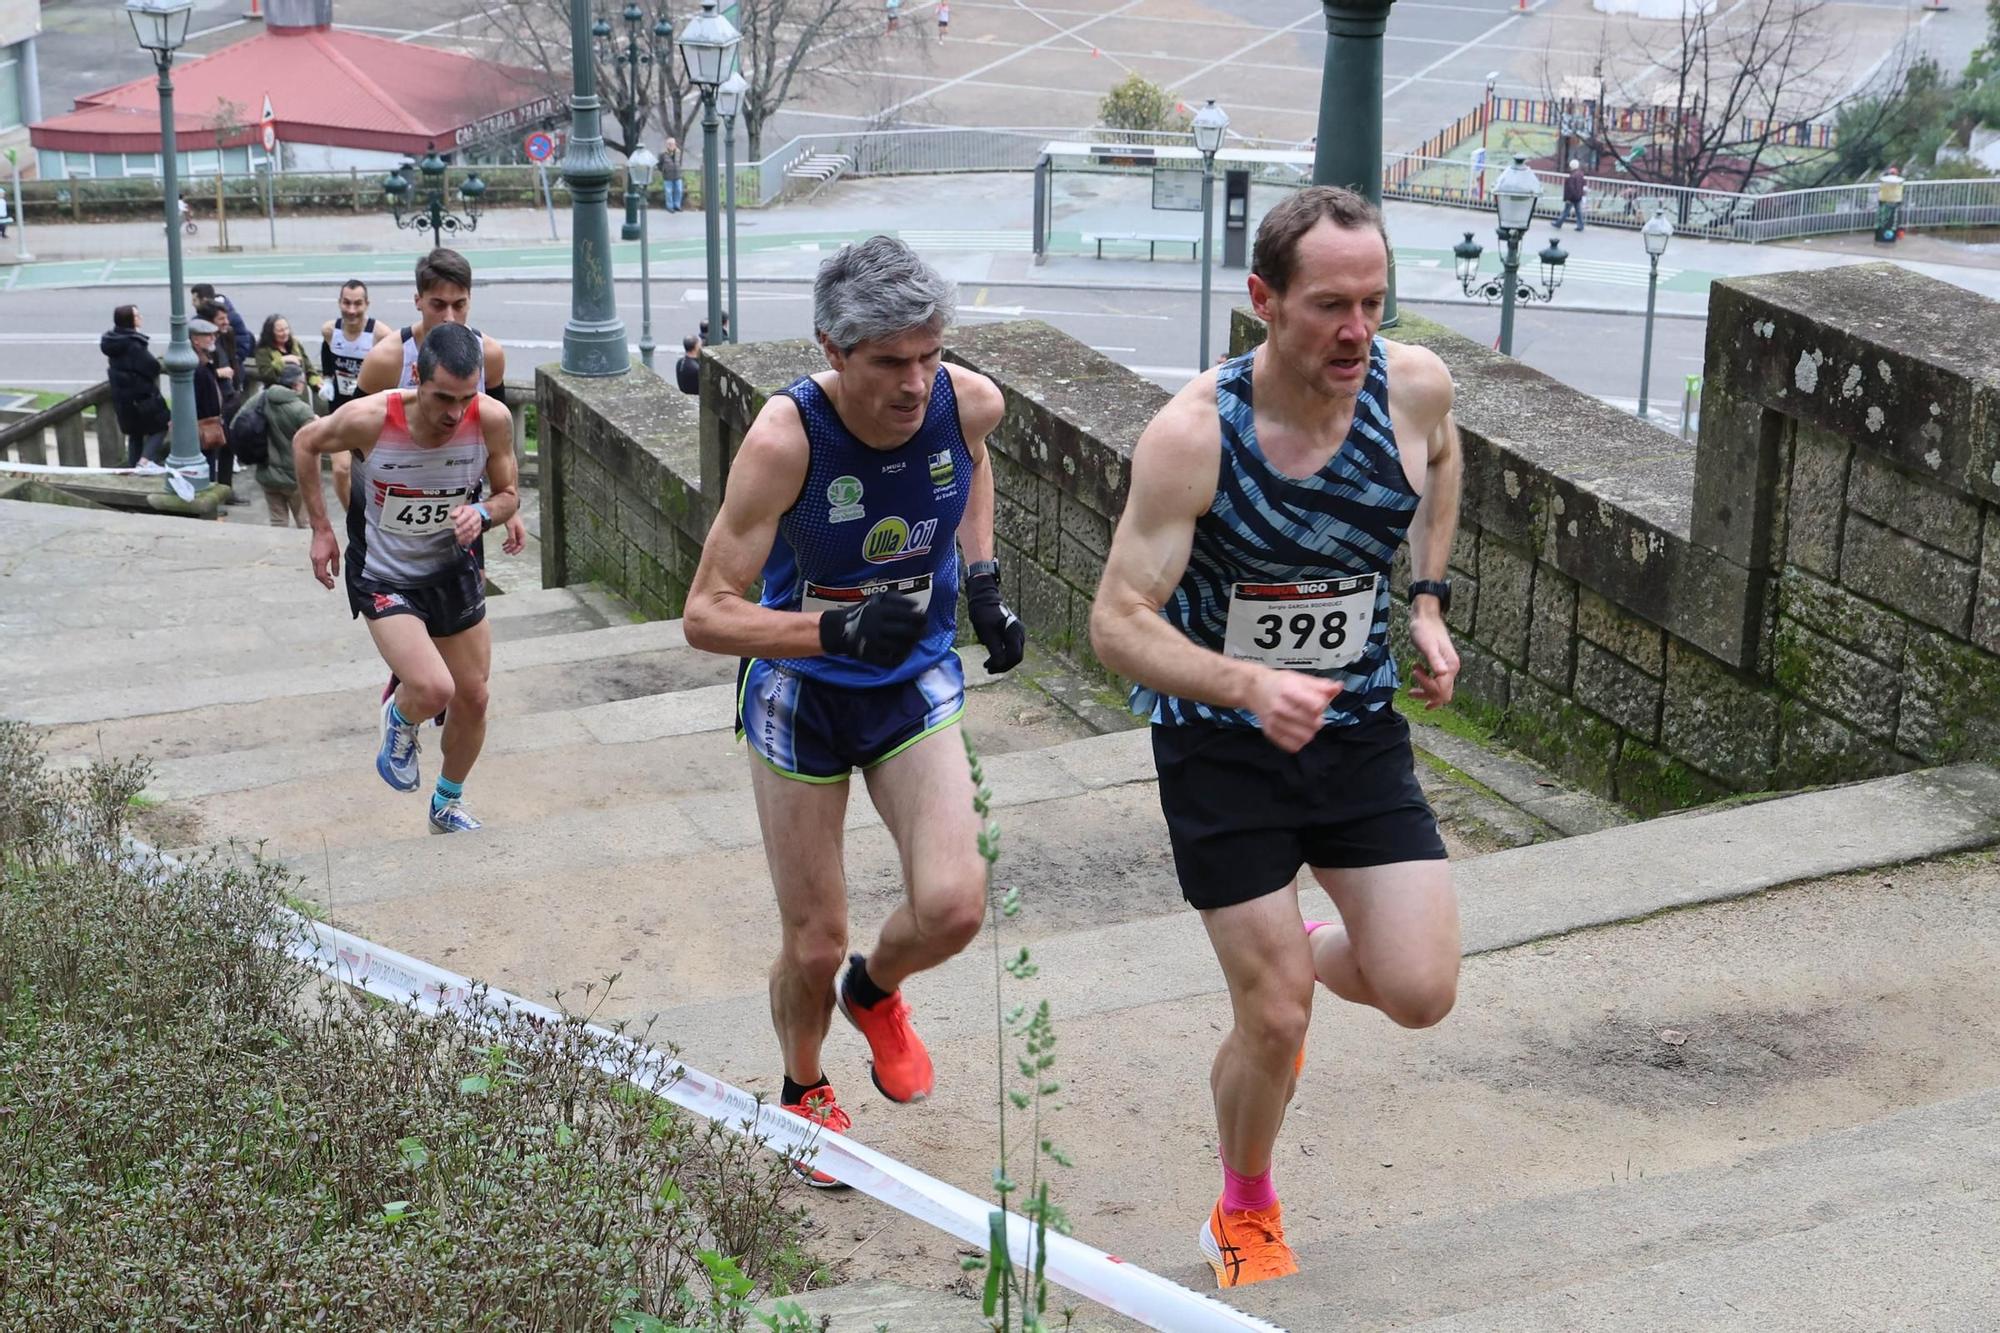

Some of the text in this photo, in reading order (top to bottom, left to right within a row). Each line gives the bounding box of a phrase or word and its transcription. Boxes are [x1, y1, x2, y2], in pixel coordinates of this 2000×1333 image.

[396, 503, 451, 525] 435
[869, 518, 938, 556] Ulla Oil
[1254, 611, 1347, 650] 398
